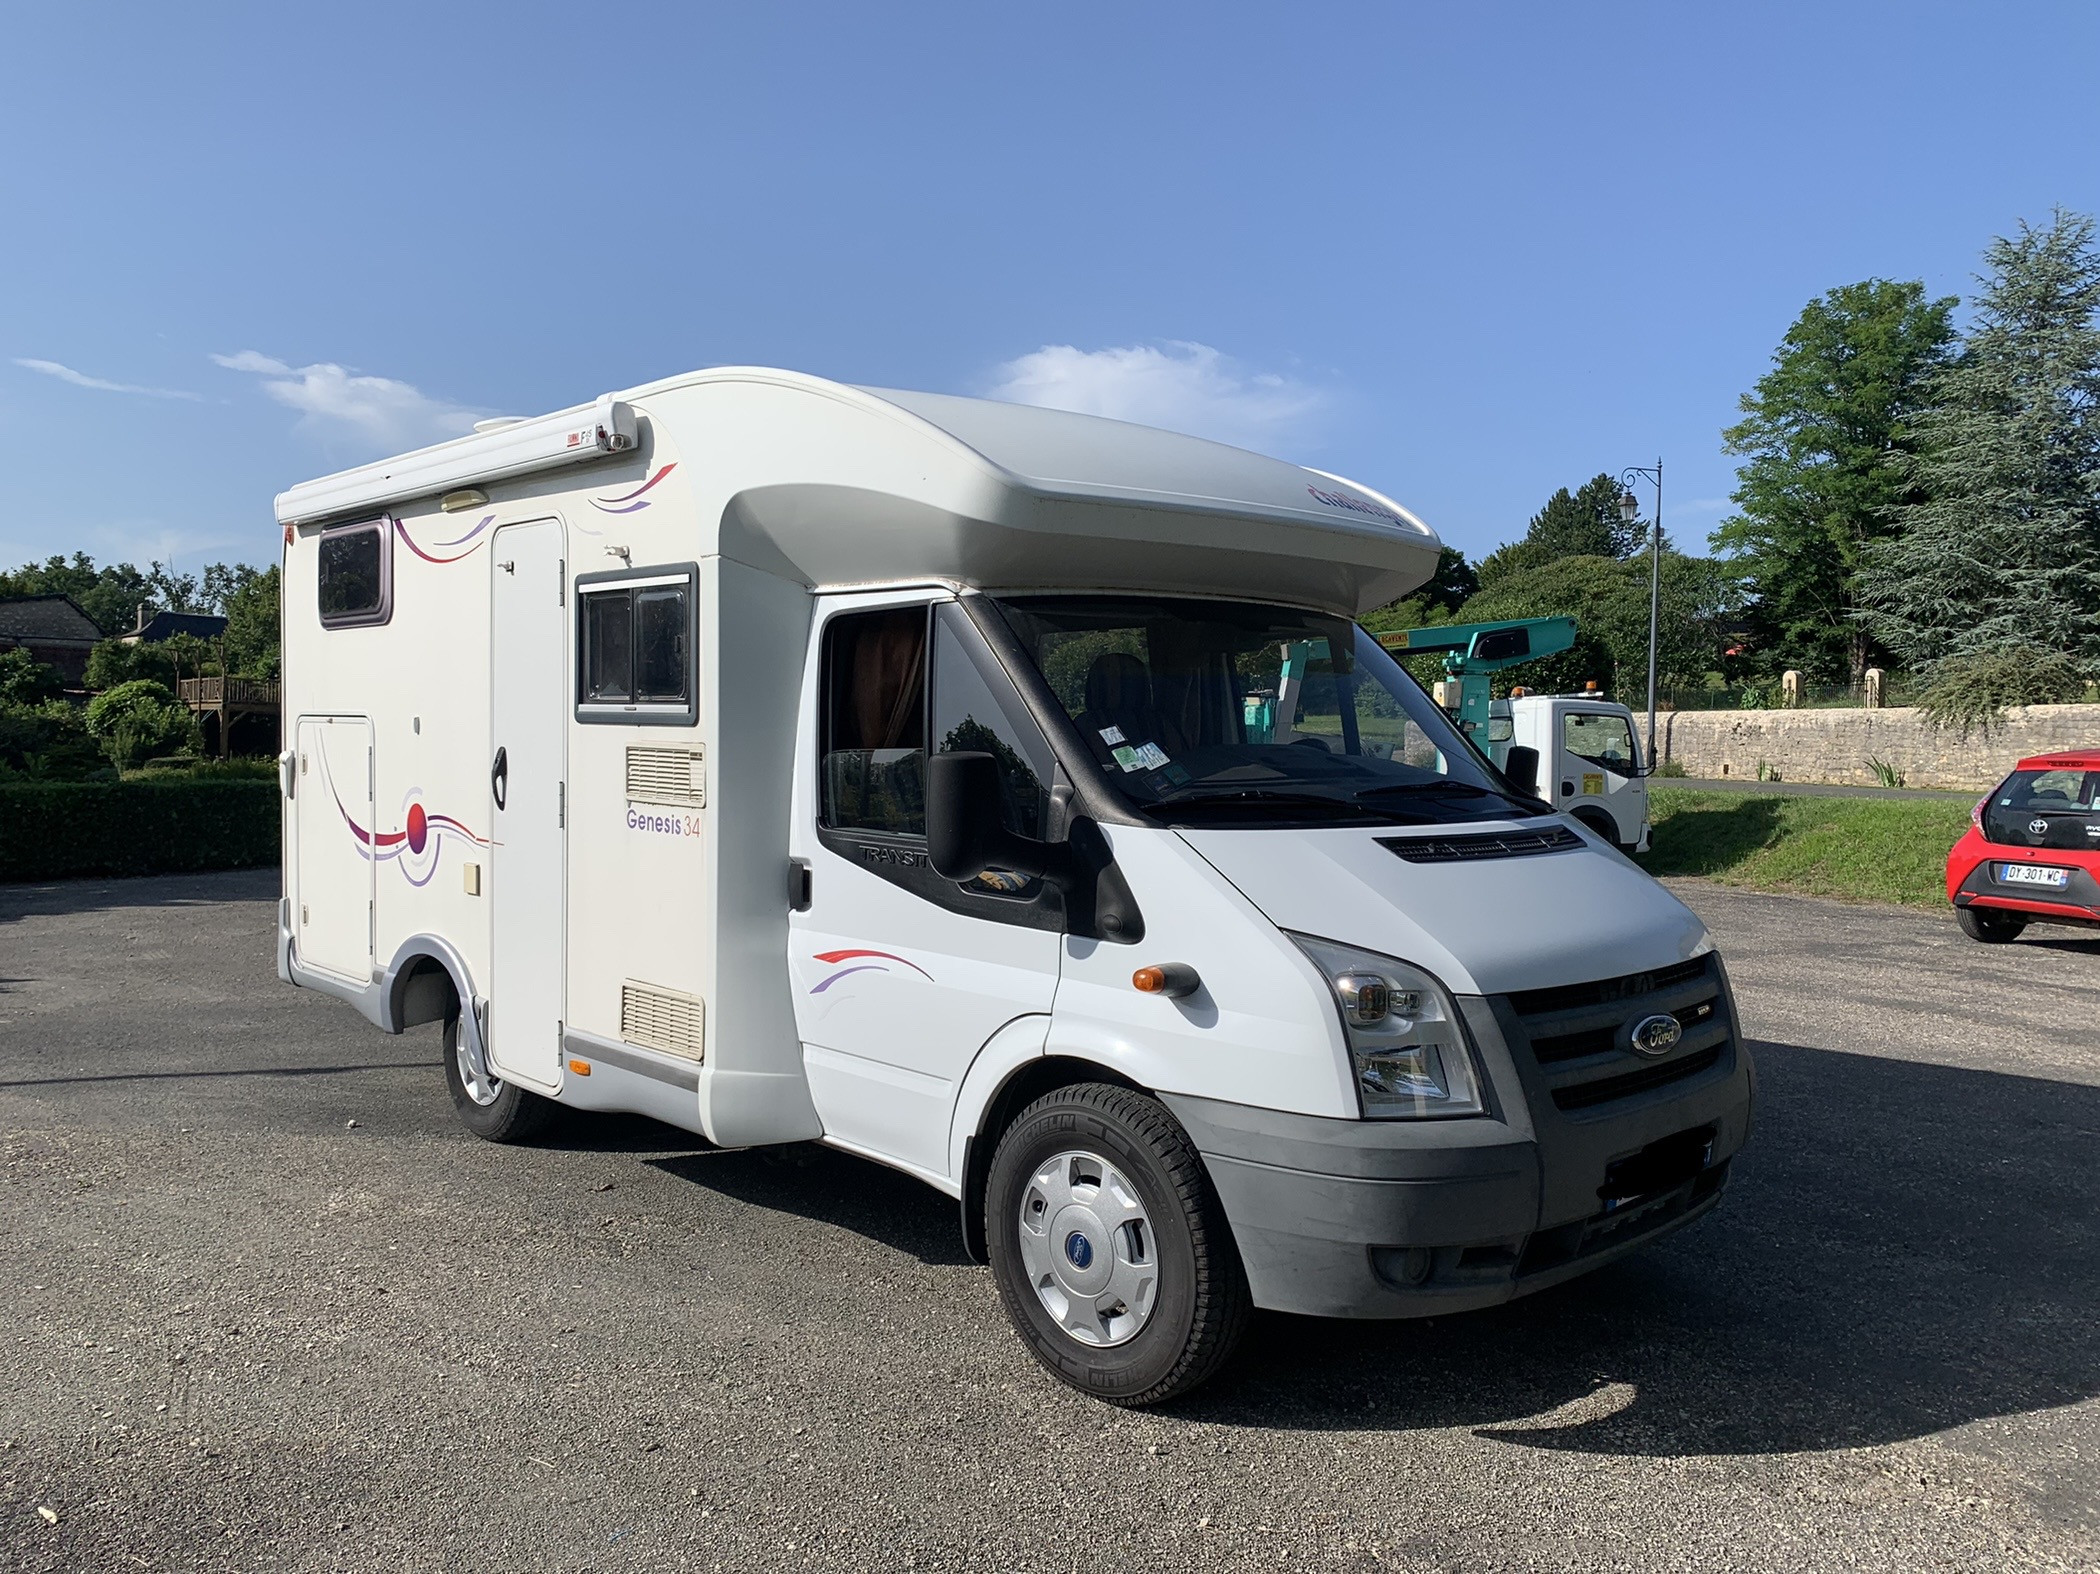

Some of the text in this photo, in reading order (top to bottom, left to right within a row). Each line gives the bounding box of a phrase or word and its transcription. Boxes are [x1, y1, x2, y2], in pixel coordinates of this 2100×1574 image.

[626, 808, 700, 838] Genesis 34
[859, 845, 928, 868] TRANSIT
[1650, 1023, 1677, 1047] Ford
